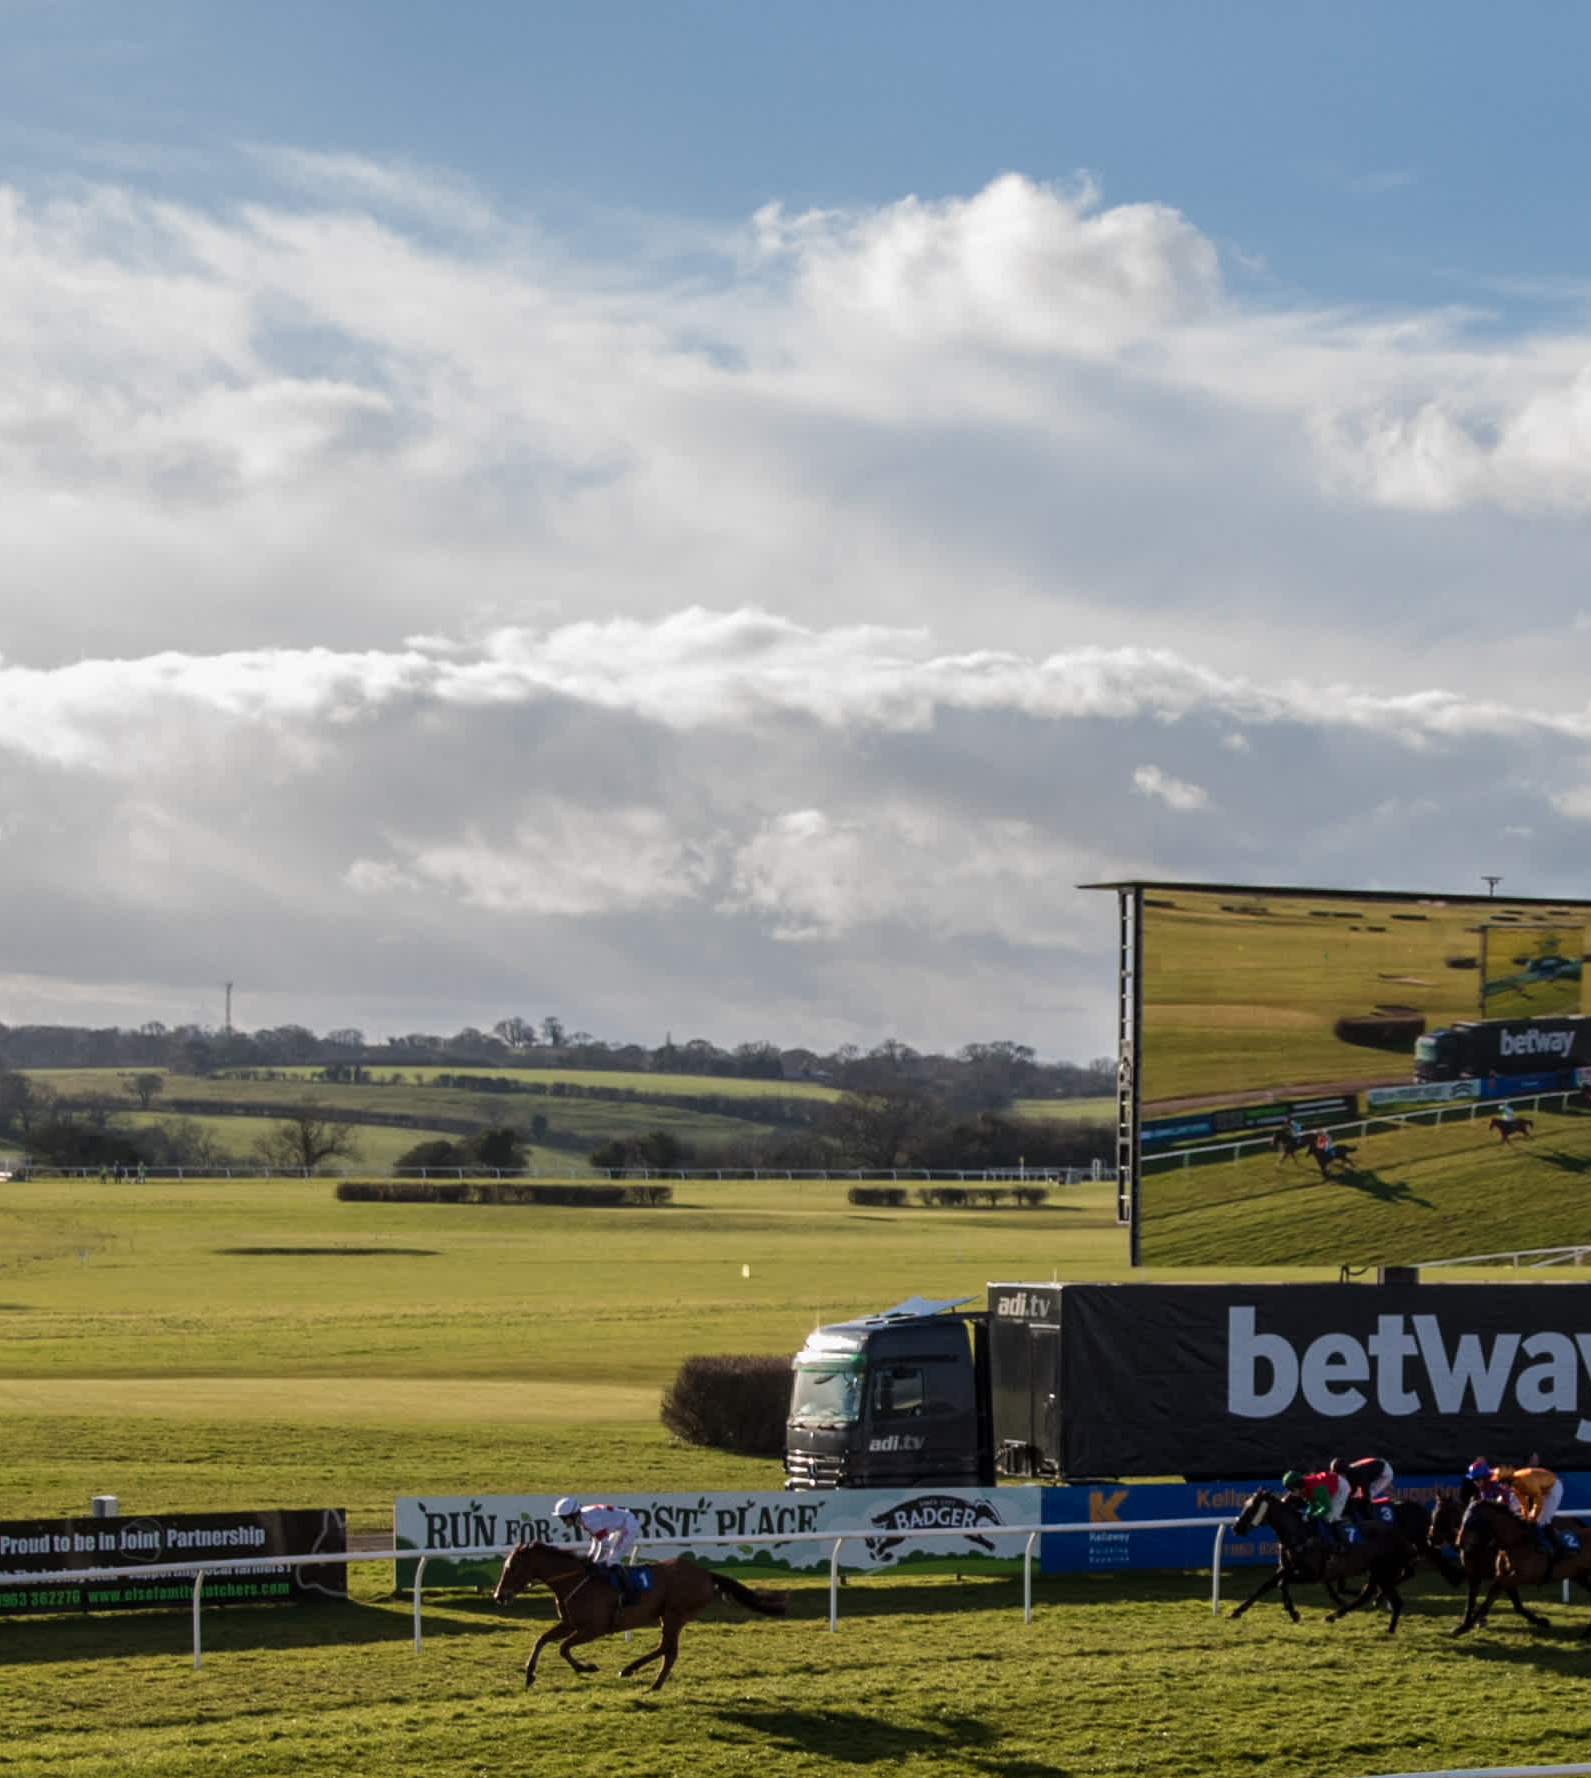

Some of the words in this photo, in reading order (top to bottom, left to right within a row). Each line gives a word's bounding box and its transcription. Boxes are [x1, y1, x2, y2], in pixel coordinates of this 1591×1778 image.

[1500, 1028, 1575, 1058] betway
[998, 1292, 1051, 1317] adi.tv
[869, 1435, 925, 1452] adi.tv
[894, 1506, 977, 1530] BADGER
[1089, 1490, 1129, 1527] K
[1380, 1506, 1392, 1521] 3
[425, 1511, 497, 1549] RUN
[505, 1518, 553, 1546] FOR
[716, 1504, 818, 1546] PLACE
[1345, 1528, 1356, 1542] 7
[0, 1533, 50, 1555] Proud
[53, 1534, 70, 1553] to
[74, 1532, 96, 1552] be
[98, 1531, 116, 1550] in
[120, 1530, 161, 1550] Joint
[167, 1526, 266, 1548] Partnership
[639, 1572, 648, 1588] 1
